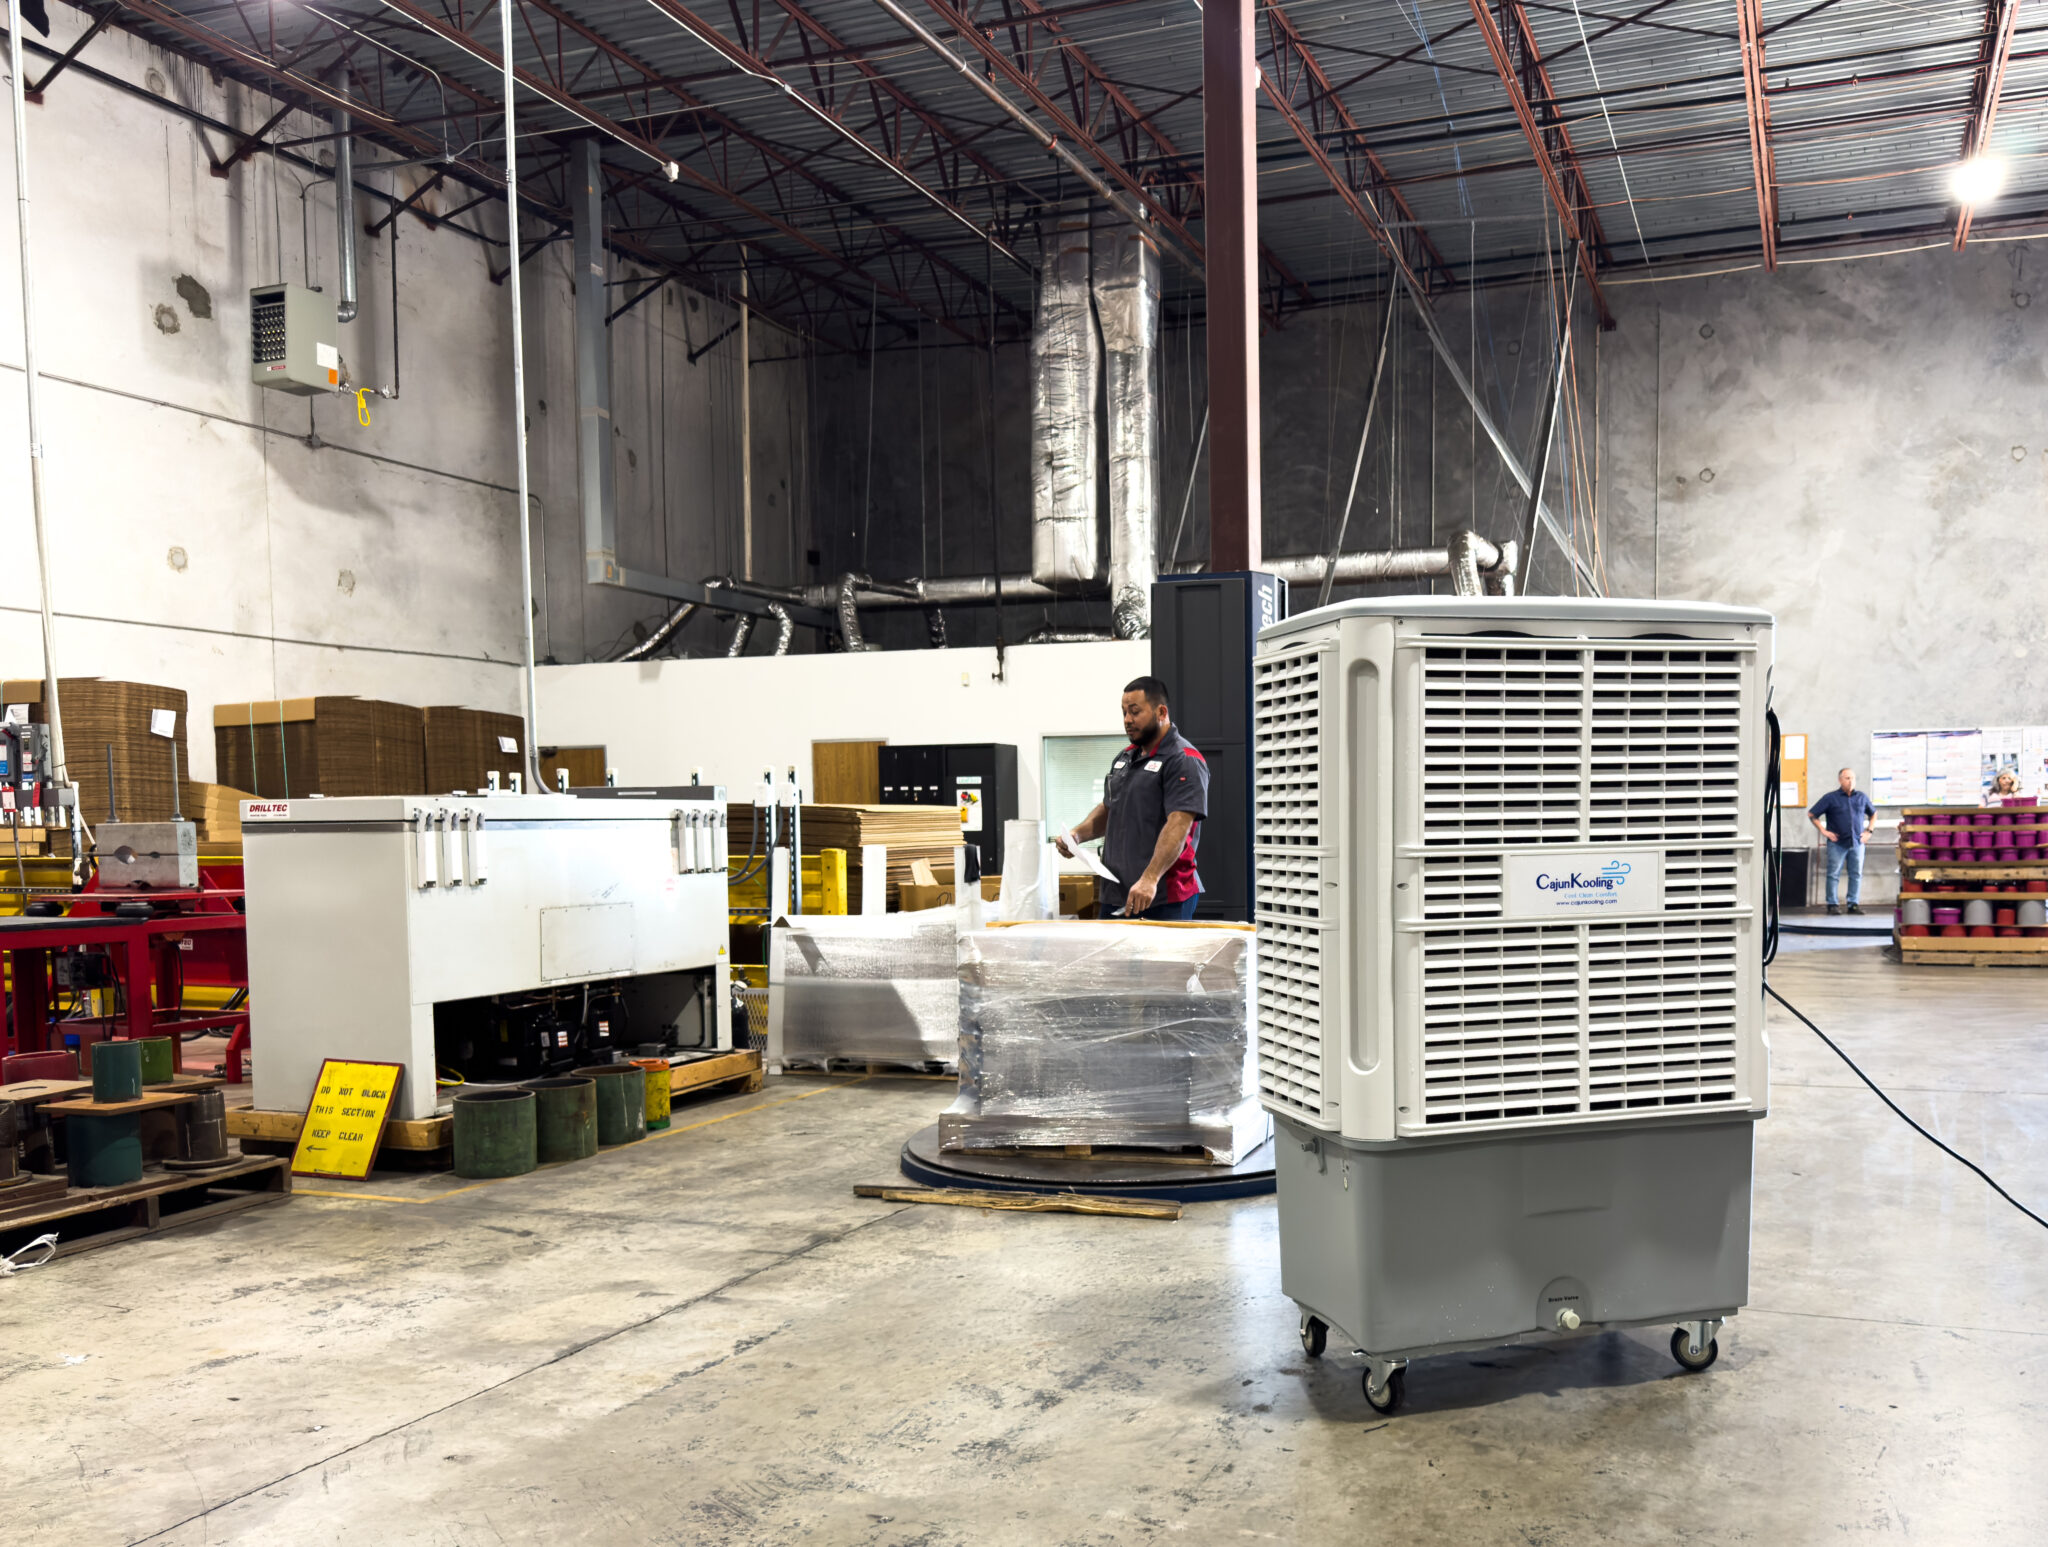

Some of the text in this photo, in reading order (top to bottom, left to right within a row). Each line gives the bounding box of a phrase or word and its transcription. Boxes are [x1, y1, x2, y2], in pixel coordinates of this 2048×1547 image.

[1257, 584, 1273, 632] ech
[249, 804, 288, 812] DRILLTEC
[1556, 898, 1618, 906] www.cajunkooling.com
[320, 1086, 387, 1099] DO NOT BLOCK
[315, 1105, 376, 1118] THIS SECTION
[312, 1129, 364, 1142] KEEP CLEAR
